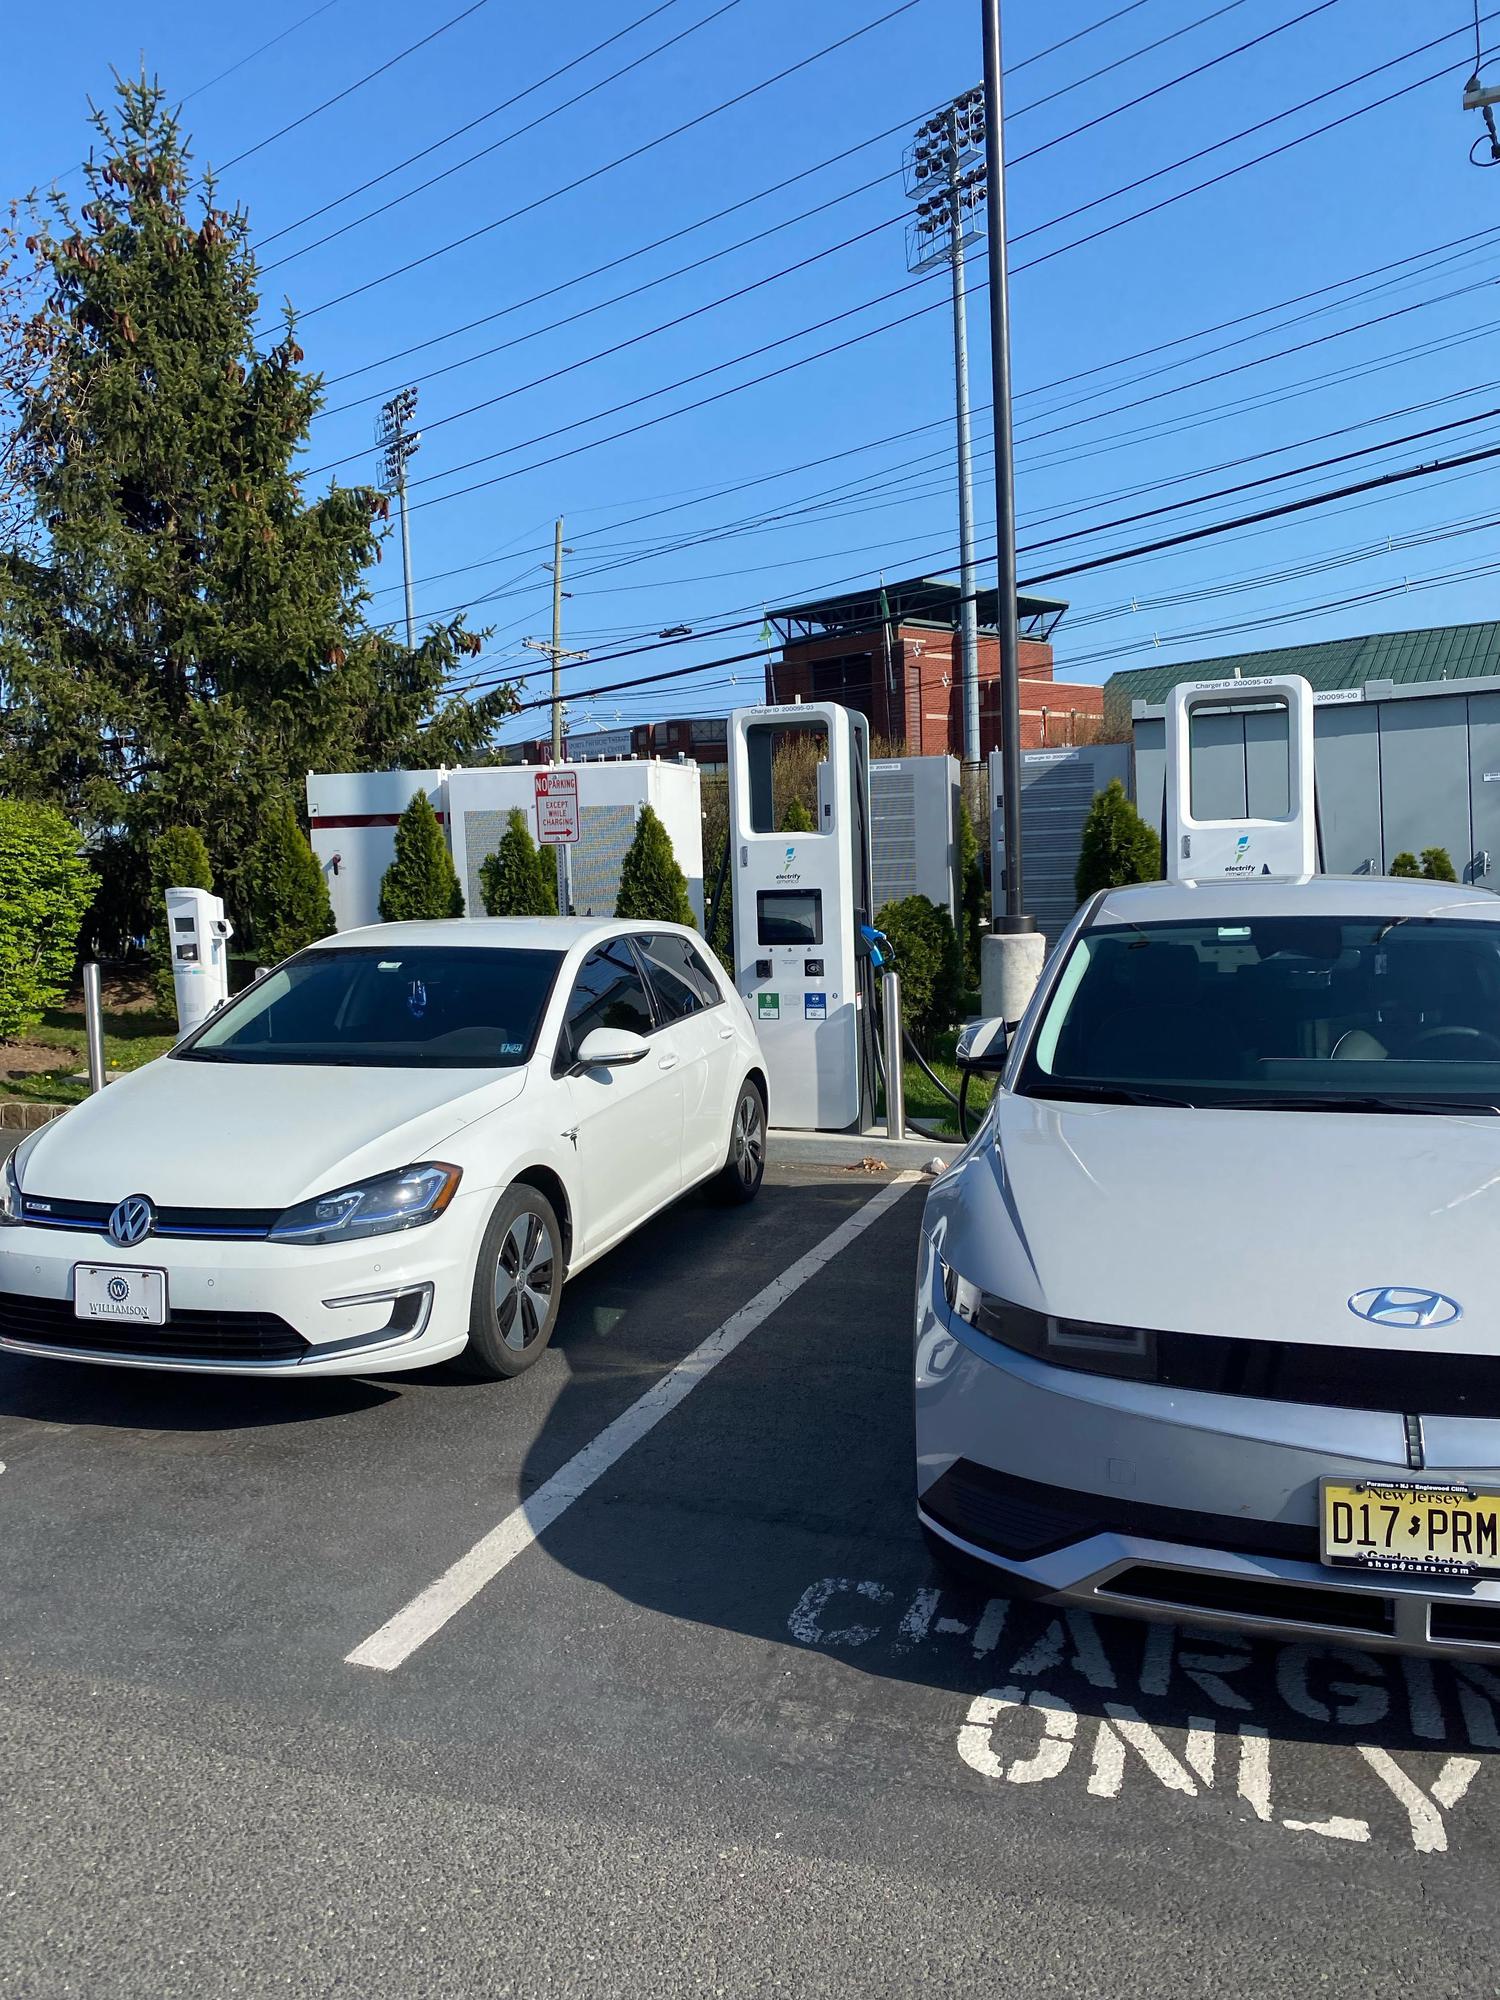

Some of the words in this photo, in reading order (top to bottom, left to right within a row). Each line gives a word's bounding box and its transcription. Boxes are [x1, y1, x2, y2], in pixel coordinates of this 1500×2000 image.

[1233, 679, 1273, 687] 200095-02
[536, 778, 548, 792] NO
[549, 779, 576, 789] PARKING
[546, 801, 568, 809] EXCEPT
[548, 809, 567, 818] WHILE
[543, 818, 574, 826] CHARGING
[89, 1303, 149, 1316] WILLIAMSON
[1366, 1480, 1394, 1489] Paramus
[1415, 1484, 1450, 1492] Englewood
[1368, 1488, 1406, 1501] New
[1410, 1491, 1464, 1508] Jersey
[1333, 1501, 1400, 1548] D17
[1428, 1509, 1498, 1556] PRM
[1367, 1560, 1469, 1575] shop4cars.com
[956, 1685, 1482, 1854] ONLY
